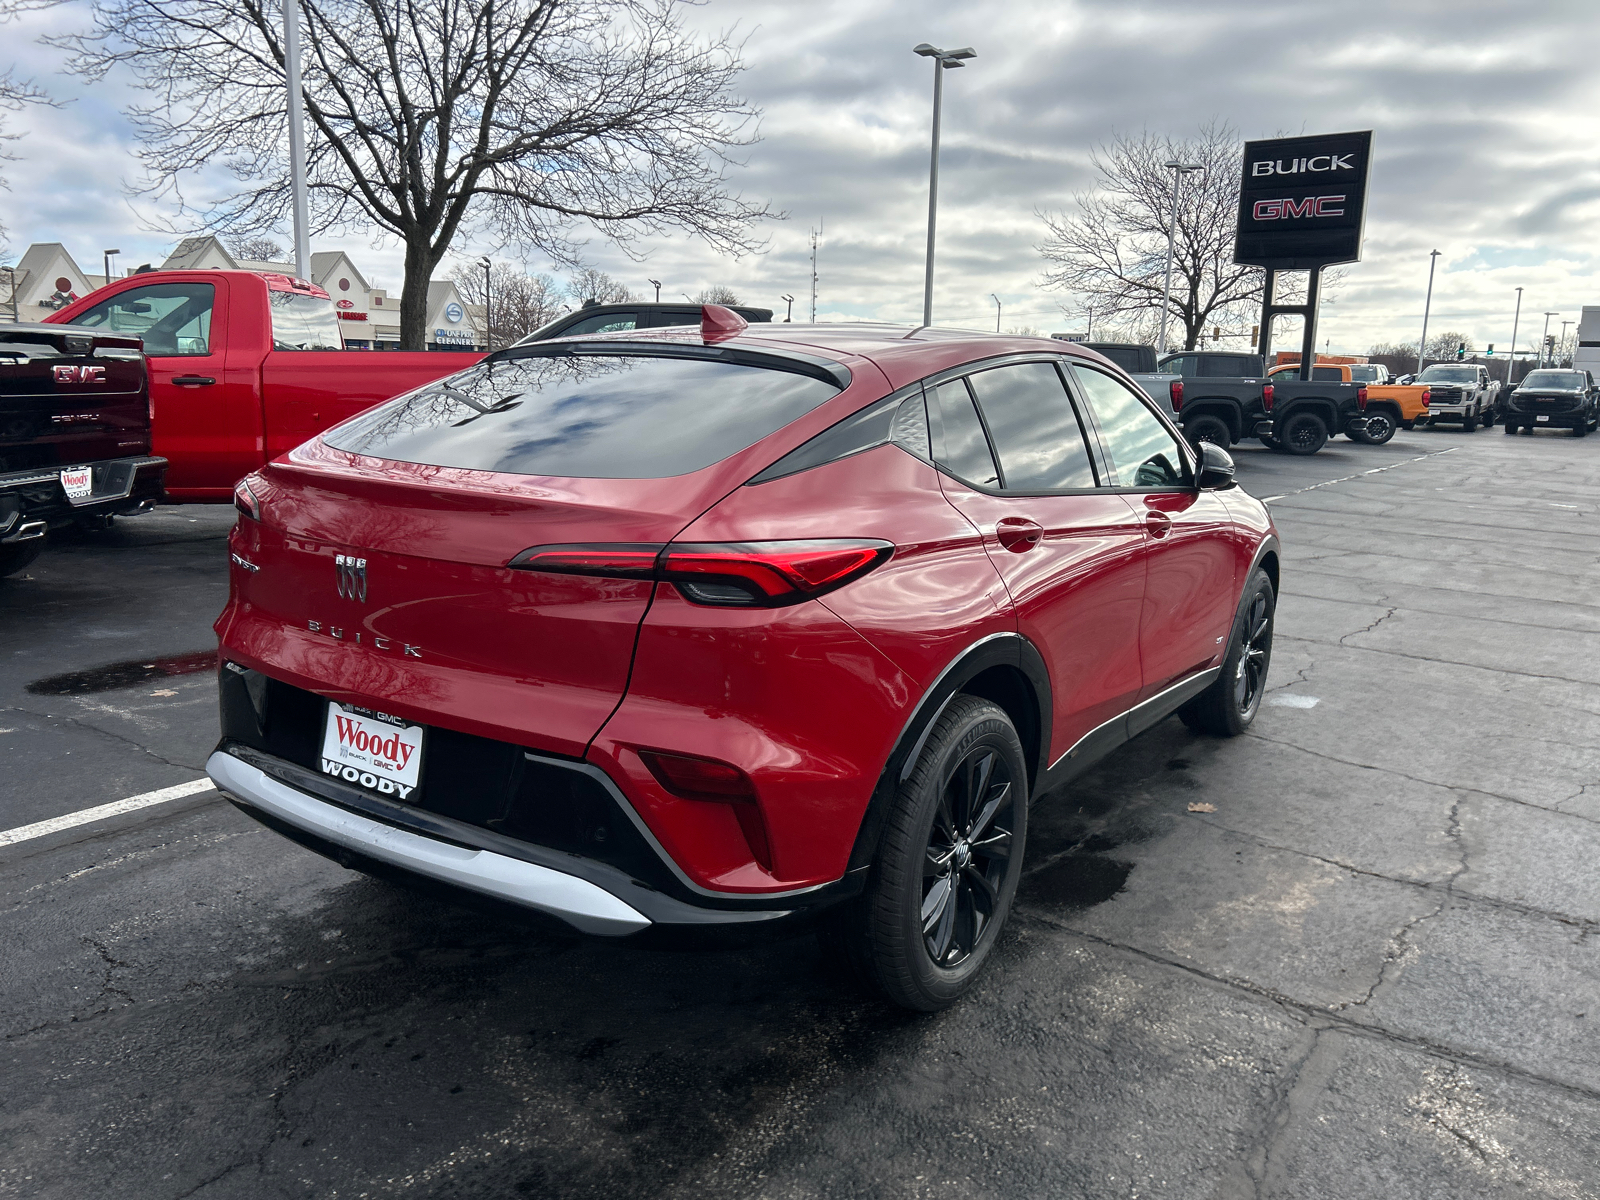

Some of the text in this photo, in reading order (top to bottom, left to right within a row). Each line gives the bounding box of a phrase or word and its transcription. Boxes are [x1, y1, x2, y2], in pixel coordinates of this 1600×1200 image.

[1252, 153, 1355, 177] BUICK
[1253, 195, 1347, 220] GMC
[436, 336, 476, 346] CLEANERS
[52, 365, 106, 383] GMC
[63, 472, 89, 486] Woody
[307, 619, 422, 657] BUICK
[376, 711, 402, 725] GMC
[335, 714, 416, 771] Woody
[348, 752, 394, 772] BUICK GMC
[321, 758, 413, 800] WOODY
